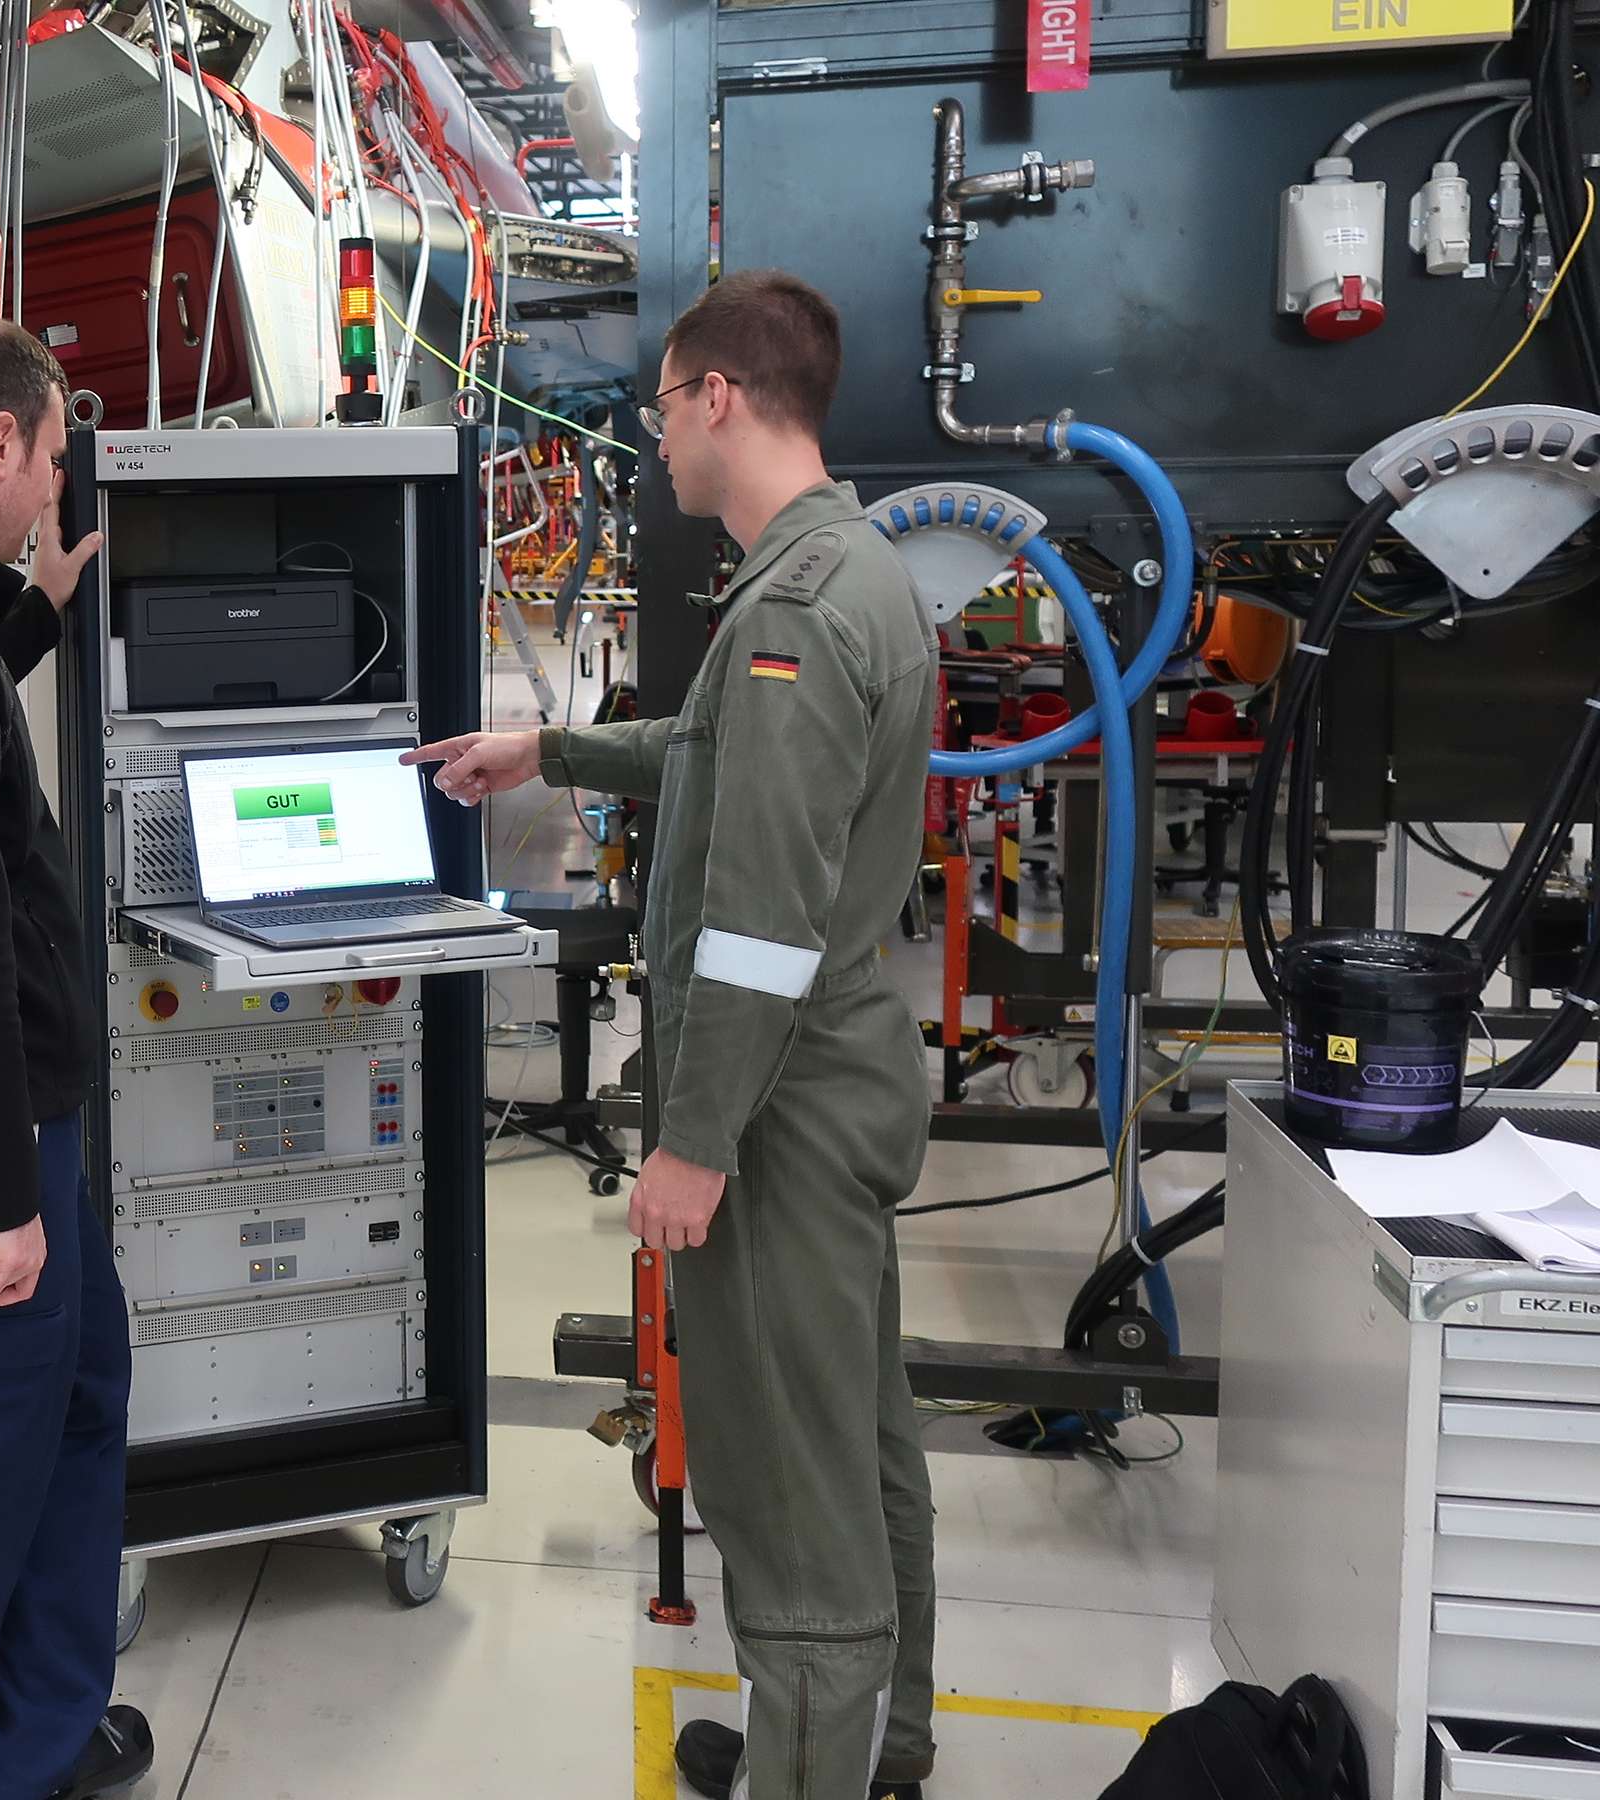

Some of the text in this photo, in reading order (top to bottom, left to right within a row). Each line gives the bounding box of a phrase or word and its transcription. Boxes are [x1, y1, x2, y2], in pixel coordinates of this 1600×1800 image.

[1332, 0, 1408, 31] EIN
[116, 461, 144, 471] W 454
[227, 607, 261, 619] brother
[266, 793, 300, 809] GUT
